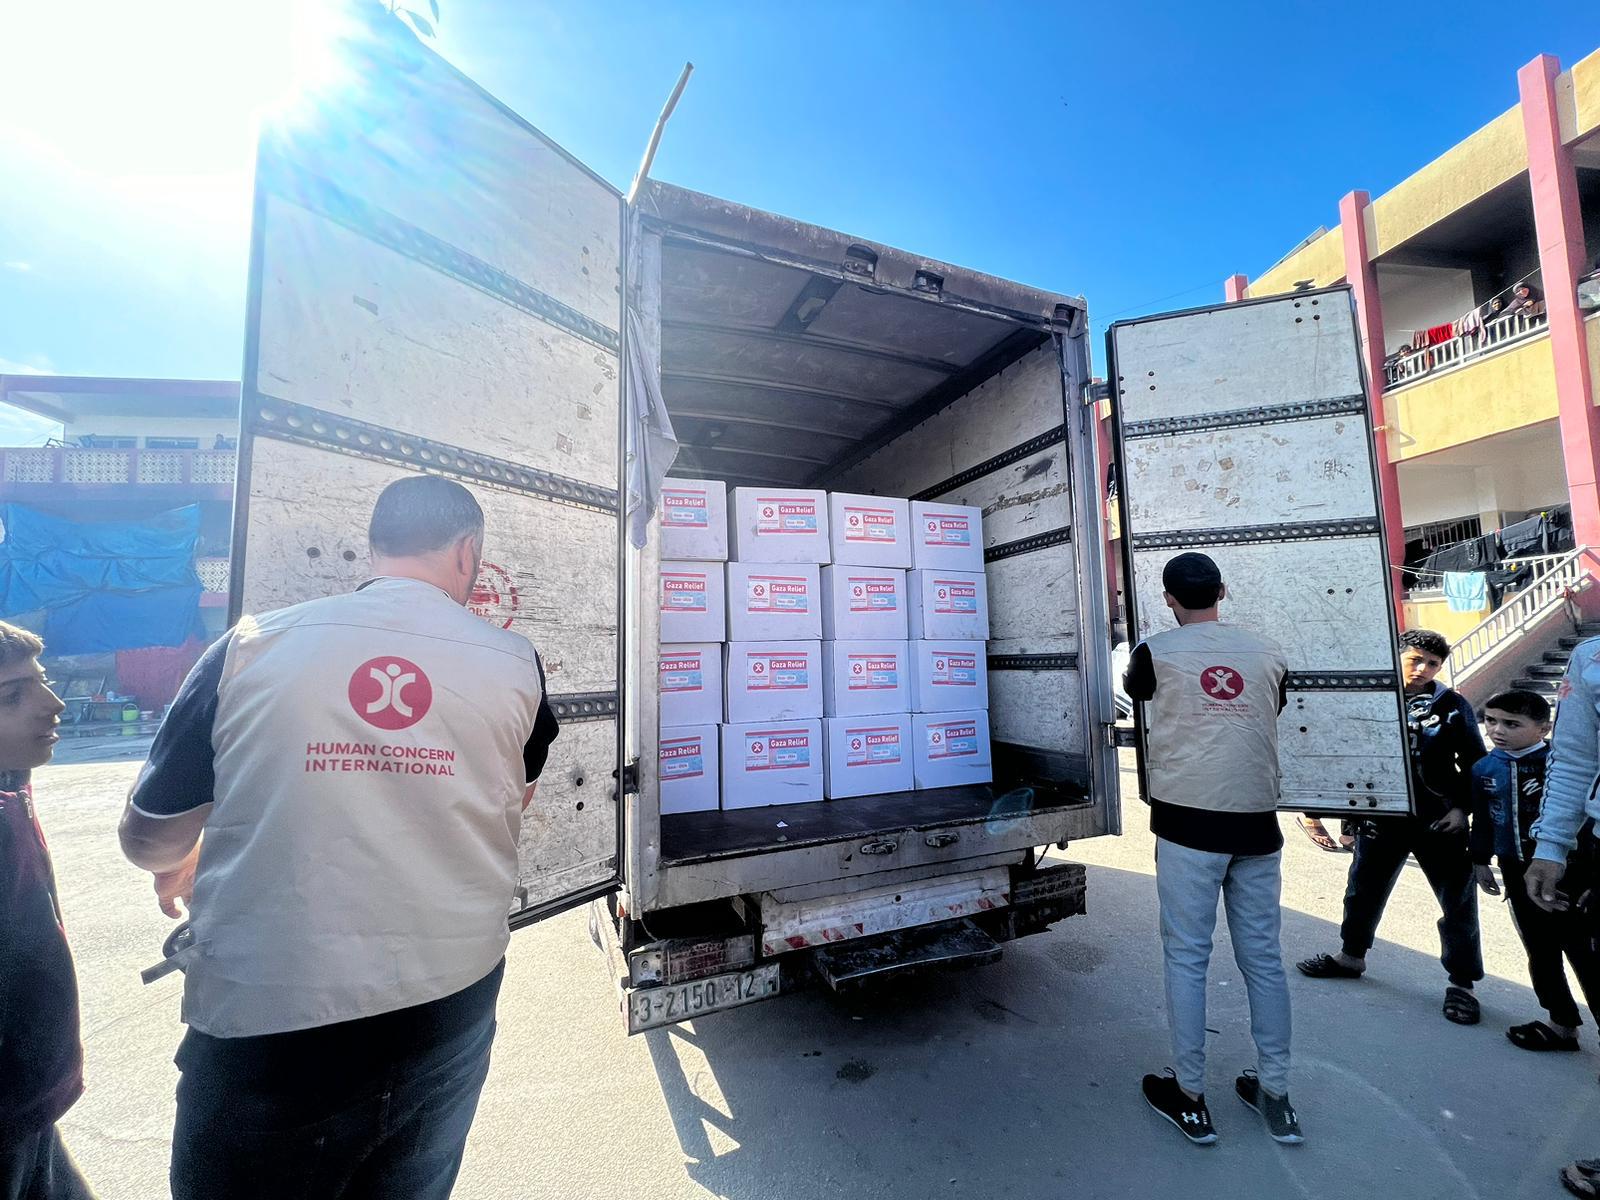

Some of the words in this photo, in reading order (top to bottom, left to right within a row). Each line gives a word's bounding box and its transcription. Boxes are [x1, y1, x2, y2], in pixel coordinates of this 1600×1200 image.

[796, 506, 814, 514] Relief
[864, 515, 877, 523] Gaza
[878, 516, 893, 524] Relief
[666, 581, 683, 589] Gaza
[684, 582, 704, 590] Relief
[771, 584, 786, 592] Gaza
[787, 585, 805, 593] Relief
[660, 662, 677, 670] Gaza
[678, 661, 699, 669] Relief
[787, 660, 807, 668] Relief
[867, 662, 880, 670] Gaza
[881, 662, 895, 670] Relief
[770, 739, 786, 747] Gaza
[787, 738, 807, 746] Relief
[867, 736, 881, 744] Gaza
[881, 735, 898, 743] Relief
[306, 742, 376, 756] HUMAN
[380, 745, 455, 762] CONCERN
[660, 749, 677, 758] Gaza
[678, 746, 699, 756] Relief
[305, 759, 455, 776] INTERNATIONAL
